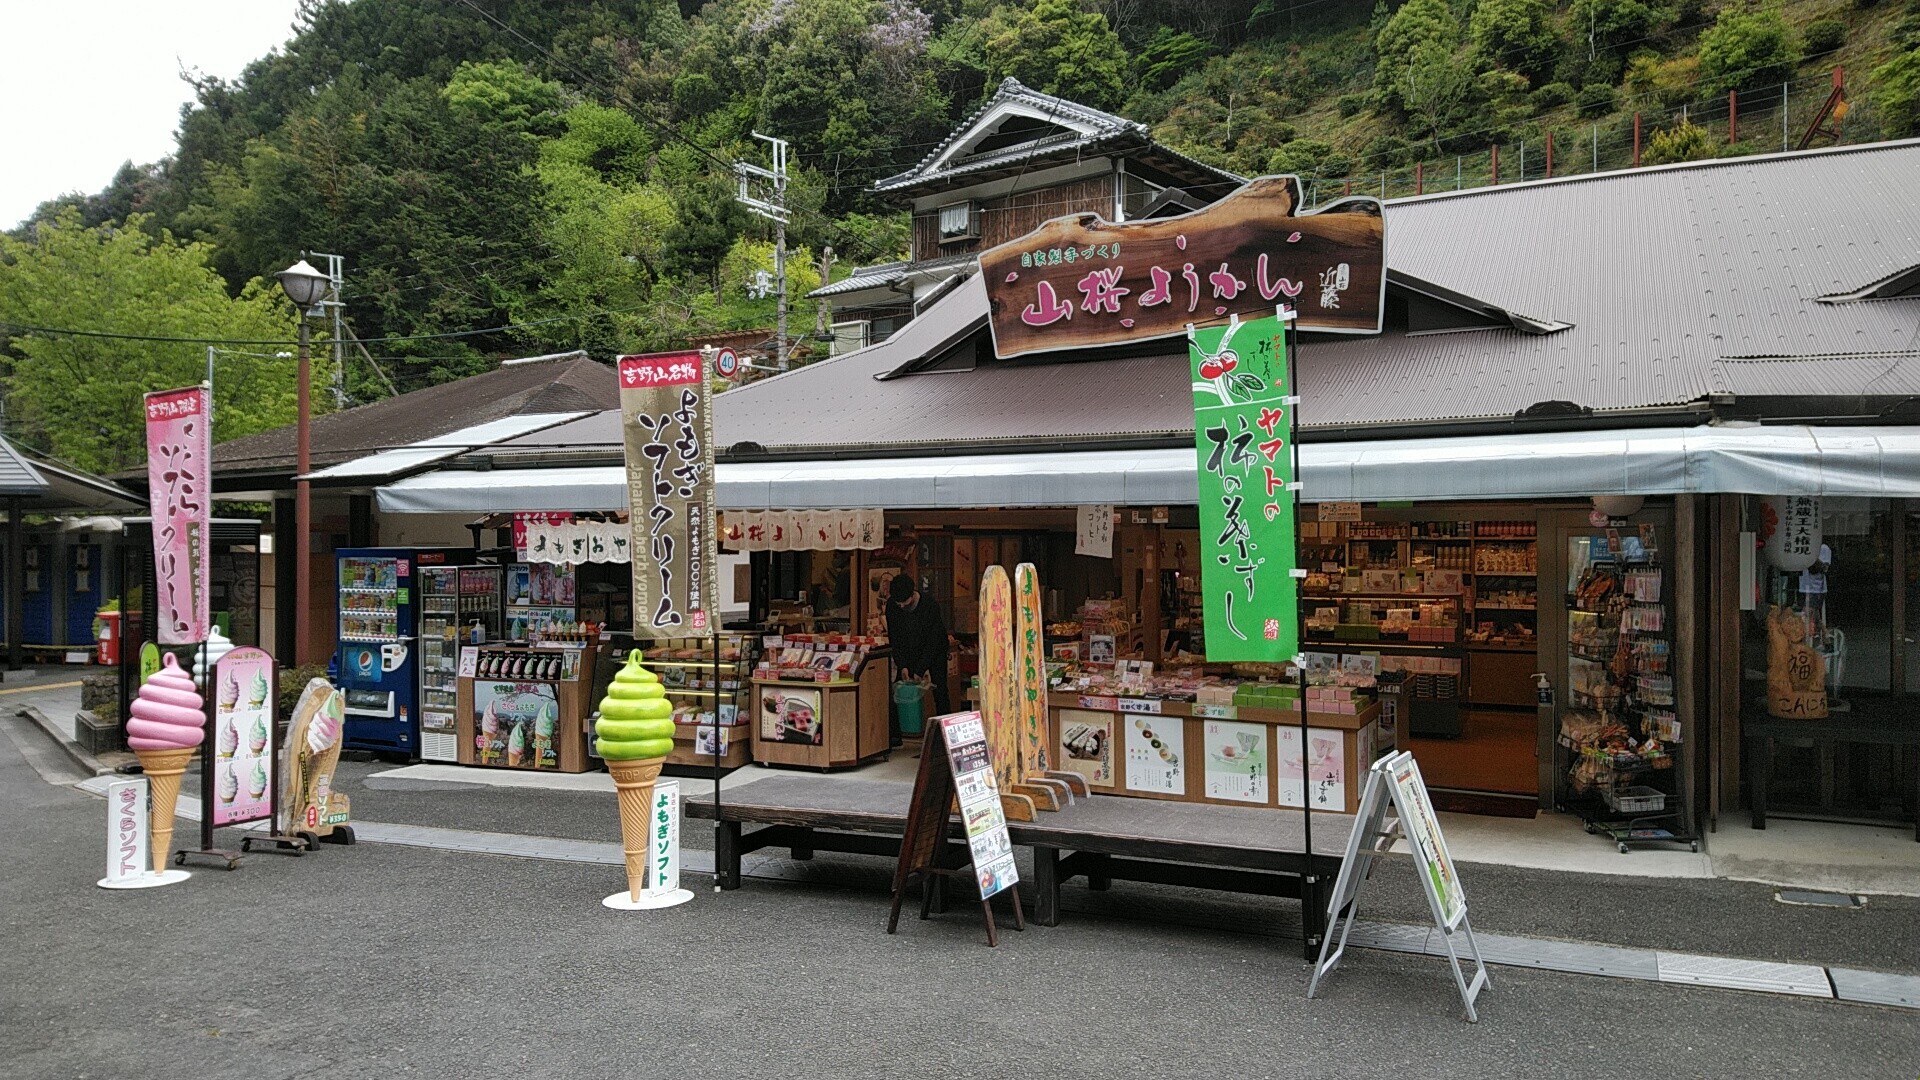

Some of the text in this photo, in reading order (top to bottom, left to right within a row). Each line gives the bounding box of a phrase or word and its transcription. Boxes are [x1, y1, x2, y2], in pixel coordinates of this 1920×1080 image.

[1021, 242, 1121, 268] 自家製手づくり
[1021, 253, 1303, 326] 山桜ようかん
[1319, 267, 1340, 309] 近藤
[622, 362, 697, 385] 吉野山名物
[722, 354, 734, 368] 40
[674, 389, 705, 497] よもぎ
[704, 431, 714, 482] SPECIALTY
[1257, 407, 1285, 521] ヤマトの
[638, 413, 682, 627] ソフトクリーム
[706, 488, 715, 538] DELICIOUS
[728, 517, 857, 543] 山桜ようかん
[160, 444, 190, 633] ソフトクリーム
[631, 462, 649, 627] Japanese herb yomogi
[709, 565, 717, 582] ICE
[710, 582, 719, 616] CREAM
[1789, 651, 1811, 680] 福
[1326, 771, 1336, 787] 山桜
[119, 788, 136, 876] さくらソフト
[656, 794, 670, 886] よもぎソフト
